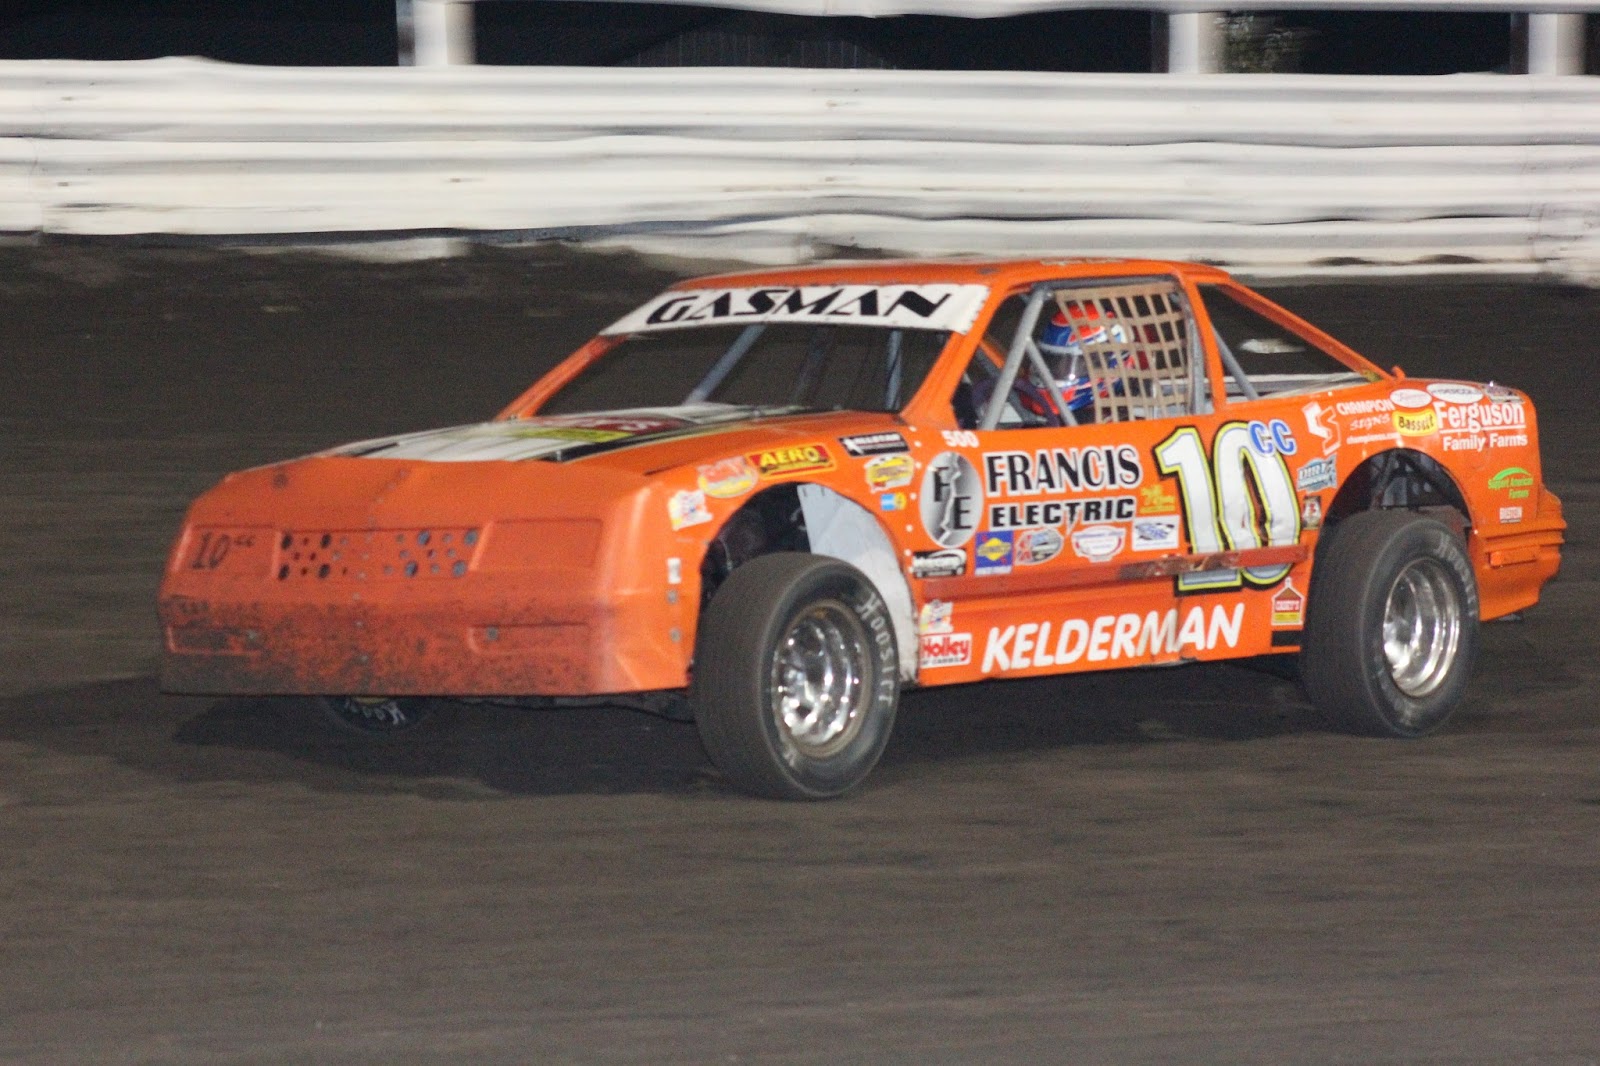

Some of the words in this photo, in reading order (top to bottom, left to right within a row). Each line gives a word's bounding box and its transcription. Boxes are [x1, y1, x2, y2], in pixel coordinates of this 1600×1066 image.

[645, 288, 952, 325] GASMAN
[1432, 402, 1526, 433] Ferguson
[941, 430, 979, 448] 500
[1443, 435, 1486, 452] Family
[1489, 433, 1529, 448] Farms
[760, 447, 820, 467] AERO
[983, 445, 1142, 497] FRANCIS
[990, 497, 1137, 528] ELECTRIC
[1154, 421, 1301, 593] 10
[980, 602, 1246, 674] KELDERMAN
